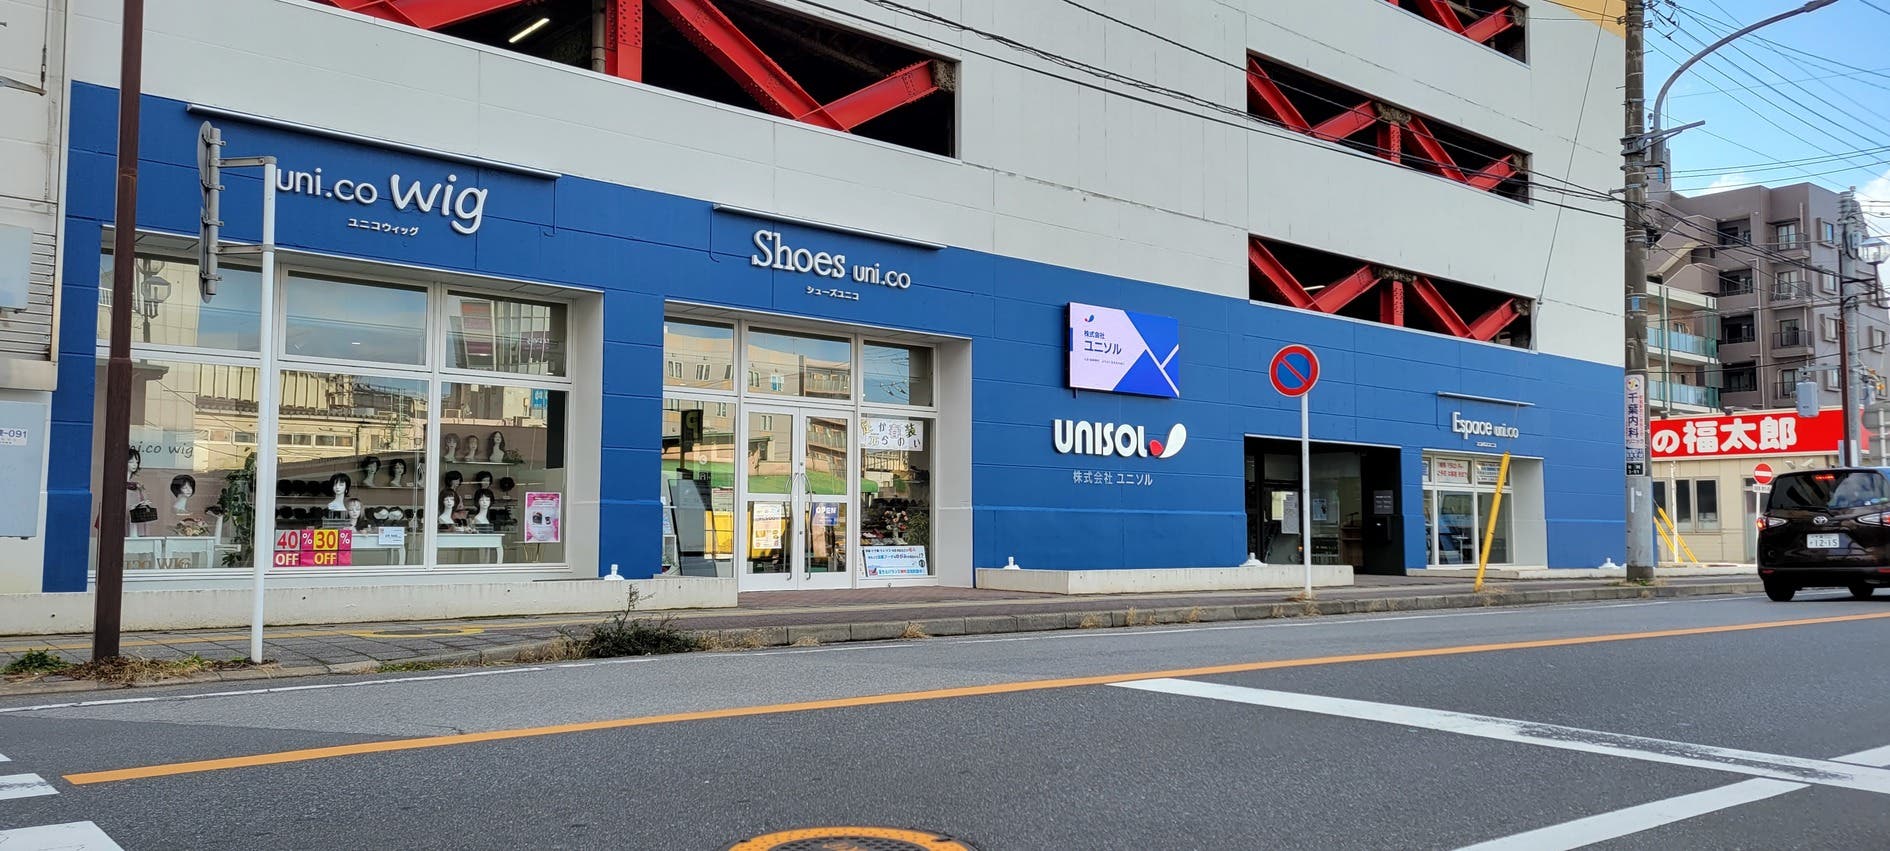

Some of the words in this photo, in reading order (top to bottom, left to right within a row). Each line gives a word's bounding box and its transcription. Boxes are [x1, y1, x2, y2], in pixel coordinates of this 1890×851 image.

[276, 167, 378, 204] uni.co
[390, 174, 488, 235] wig
[347, 218, 420, 236] ユニコウィッグ
[752, 229, 846, 278] Shoes
[853, 263, 911, 289] uni.co
[806, 286, 860, 300] シューズユニコ
[1084, 330, 1105, 340] 株式会社
[1084, 340, 1122, 355] ユニソル
[1452, 411, 1493, 440] Espace
[1054, 418, 1148, 458] UNISOL
[1652, 415, 1797, 454] の福太郎
[168, 442, 194, 459] wig
[1073, 469, 1113, 485] 株式会社
[1116, 473, 1153, 486] ユニソル
[275, 553, 299, 566] OFF
[314, 553, 337, 565] OFF
